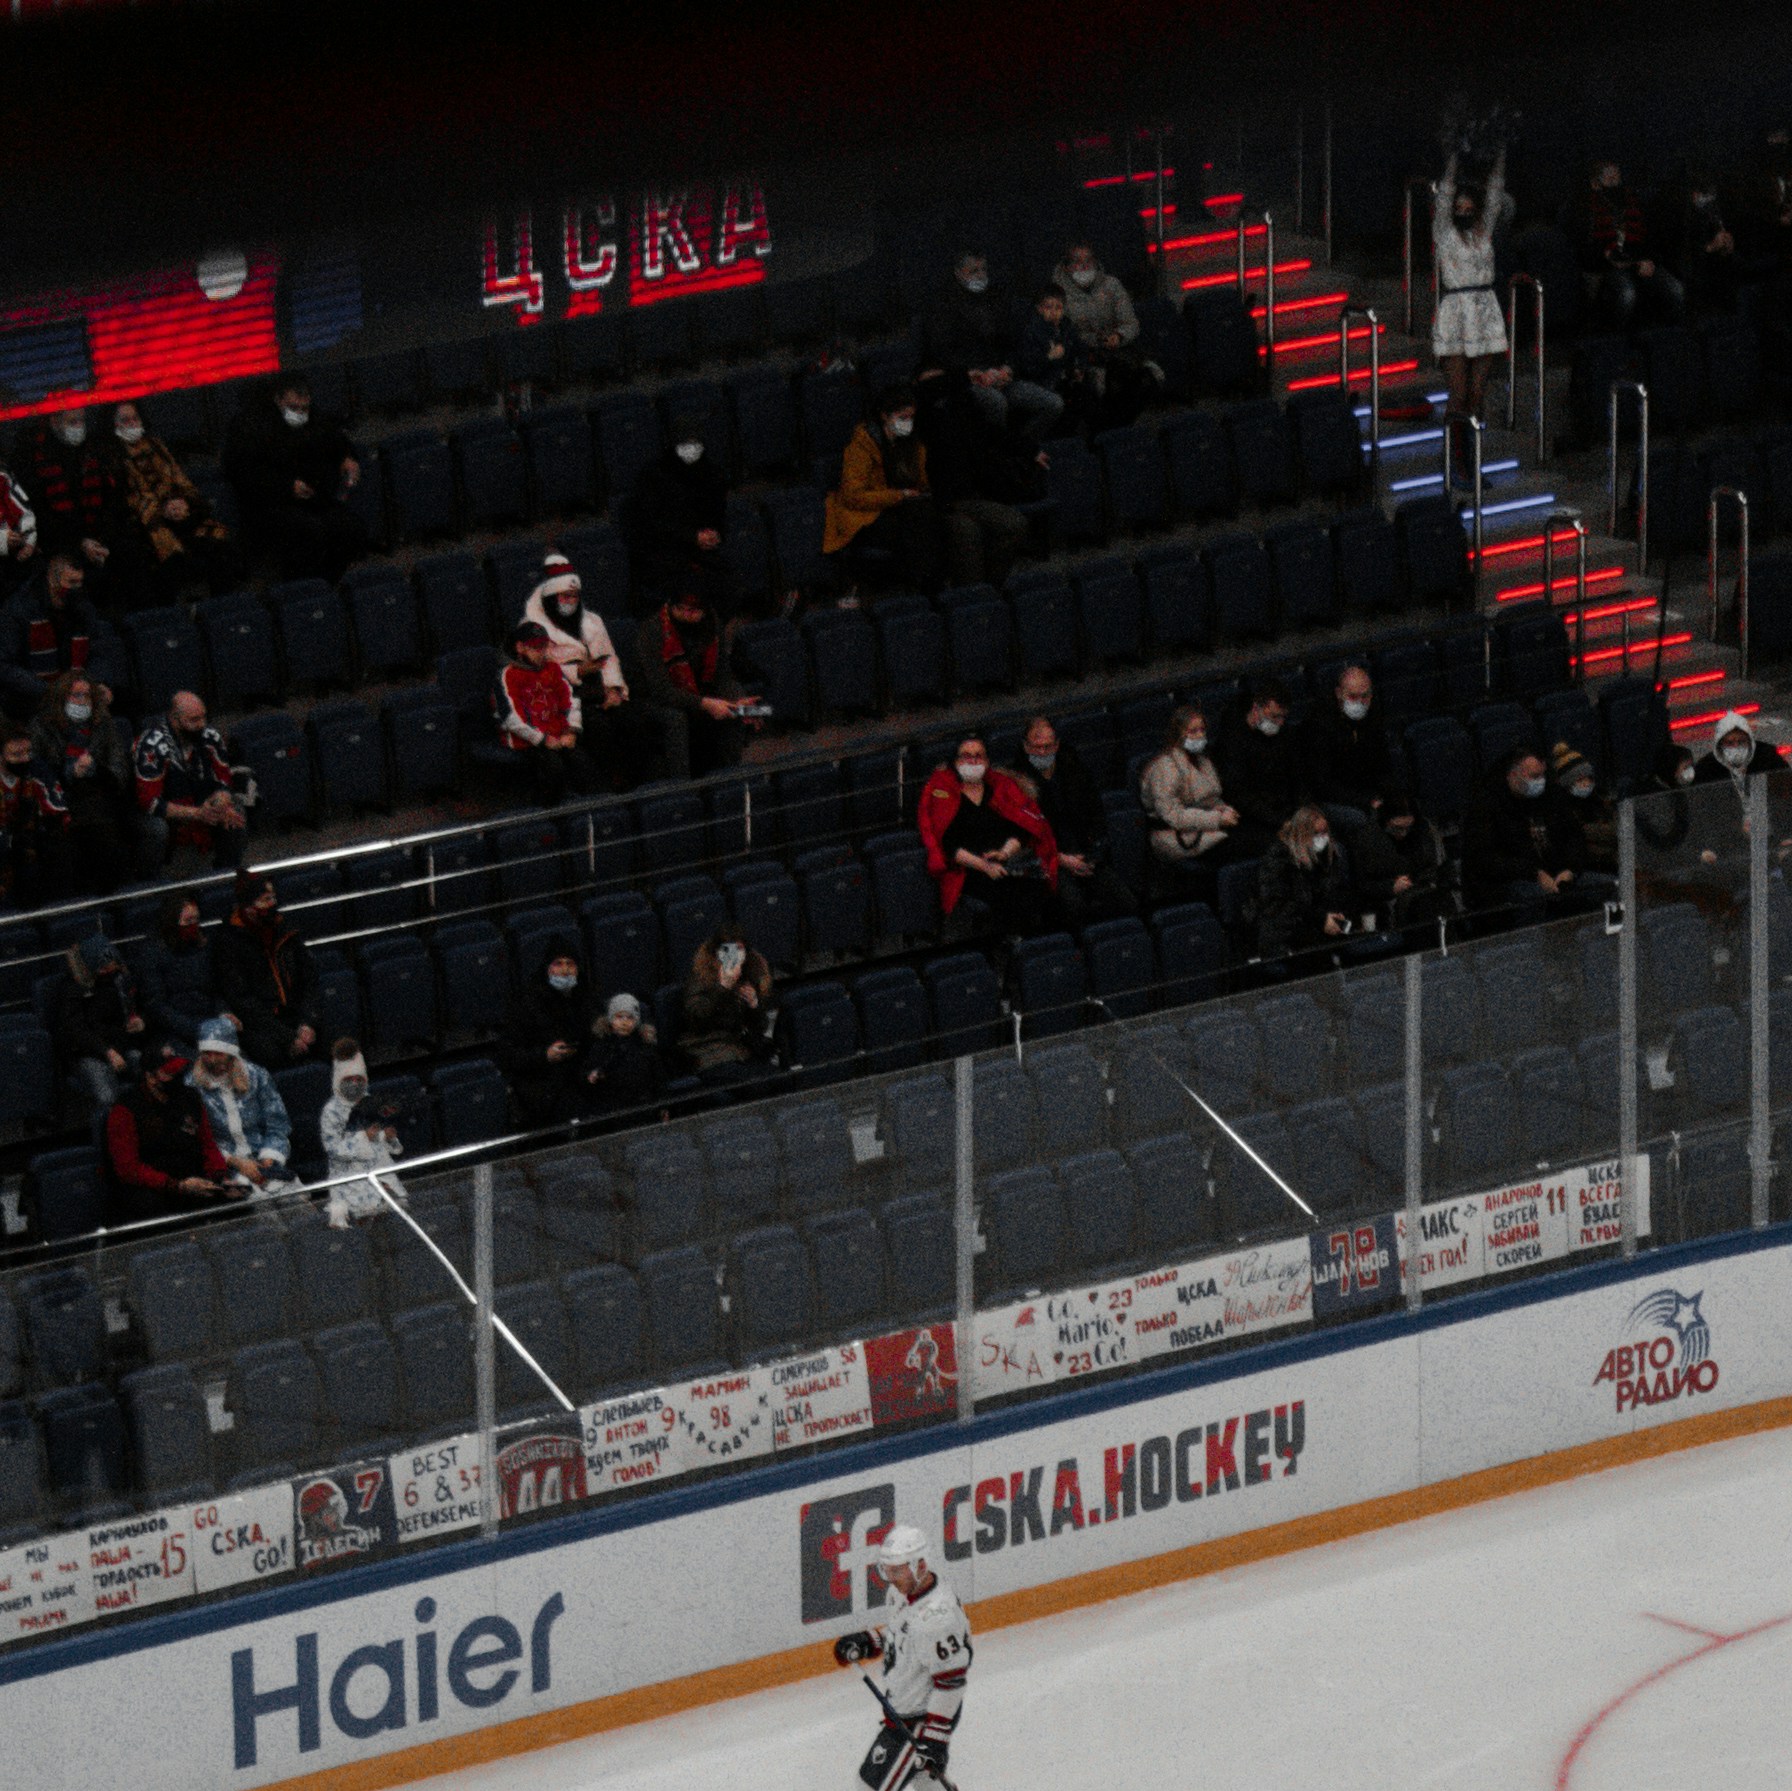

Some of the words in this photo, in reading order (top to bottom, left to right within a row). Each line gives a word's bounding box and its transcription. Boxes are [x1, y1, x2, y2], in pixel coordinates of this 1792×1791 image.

[482, 182, 772, 313] ЦСКА
[1547, 1186, 1566, 1216] 11
[1579, 1182, 1622, 1206] ВСЕГД
[1493, 1202, 1539, 1230] СЕРГЕЙ
[1583, 1203, 1621, 1226] БУДЕ
[1329, 1226, 1381, 1297] 78
[1496, 1243, 1543, 1267] СКОРЕЙ
[1135, 1270, 1178, 1292] ТОЛЬКО
[1108, 1288, 1133, 1311] 23
[1135, 1310, 1178, 1335] ТОЛЬКО
[1170, 1319, 1225, 1348] ПОБЕДА
[1067, 1351, 1093, 1375] 23
[1593, 1335, 1676, 1382] АВТО
[690, 1376, 751, 1402] МАМИН
[784, 1370, 851, 1399] ЗАЩИЩАЕТ
[1615, 1359, 1720, 1413] РАДИО
[605, 1418, 649, 1444] АНТОН
[661, 1406, 676, 1433] 9
[710, 1404, 733, 1431] 98
[775, 1402, 815, 1428] ЦСКА
[803, 1407, 871, 1438] ПРОПУСКАЕТ
[412, 1446, 459, 1478] BEST
[612, 1452, 661, 1484] ГОЛОВ!
[355, 1467, 384, 1514] 7
[404, 1481, 420, 1507] 6
[434, 1475, 454, 1502] &
[943, 1400, 1307, 1562] CSKA.HOCKEY
[25, 1545, 49, 1565] МЫ
[161, 1533, 187, 1579] 15
[253, 1536, 288, 1574] GO!
[935, 1633, 962, 1662] 63
[232, 1591, 565, 1770] Haier
